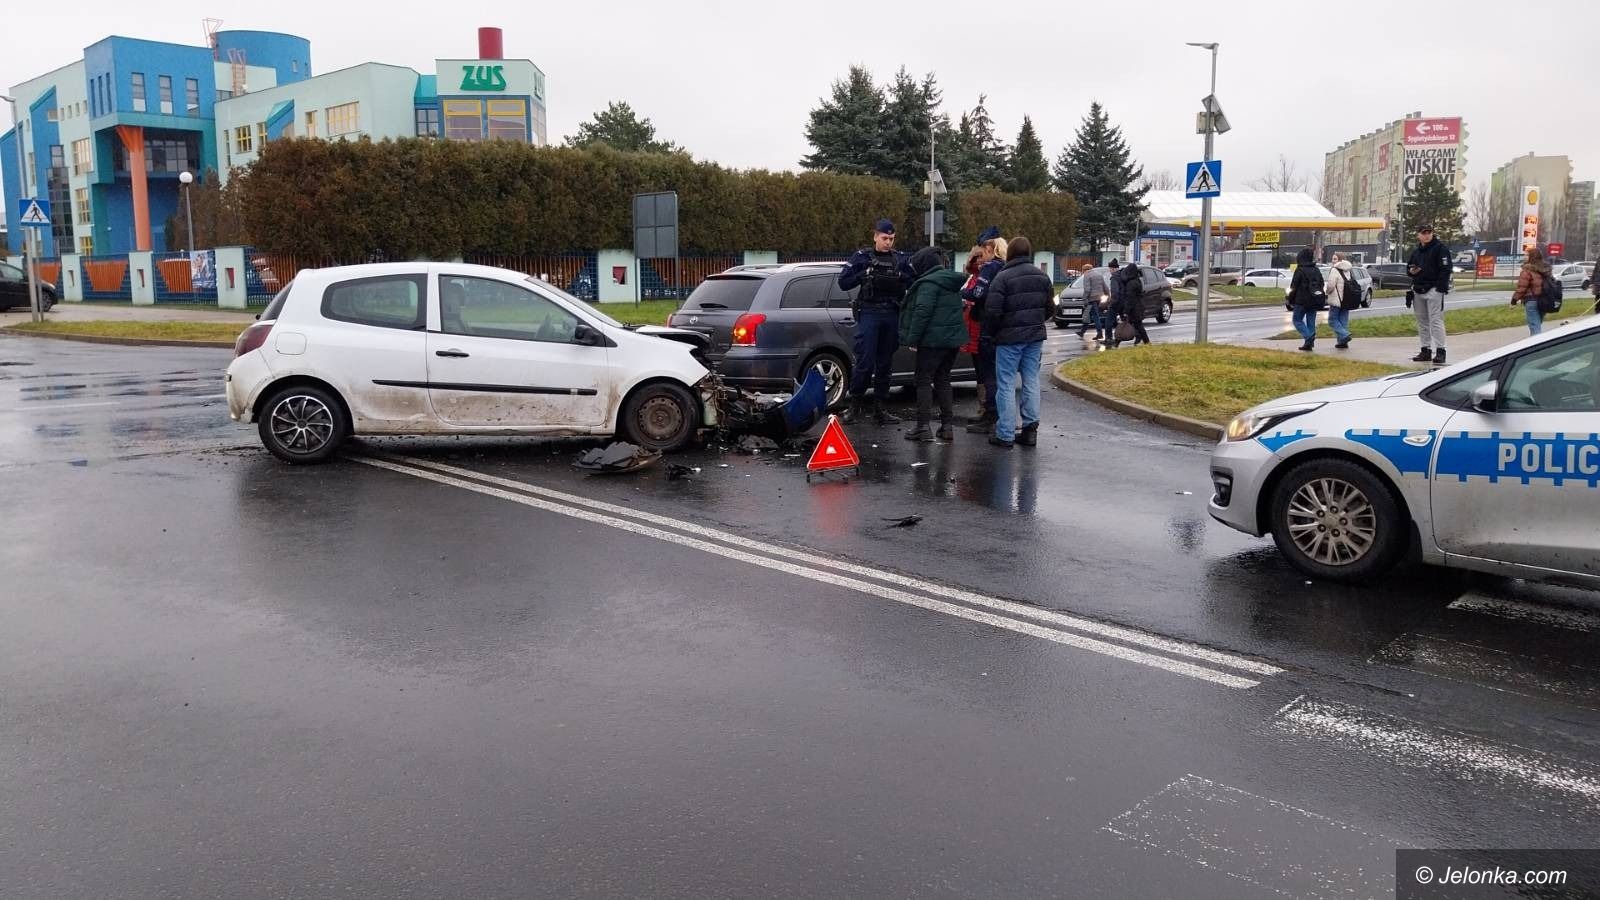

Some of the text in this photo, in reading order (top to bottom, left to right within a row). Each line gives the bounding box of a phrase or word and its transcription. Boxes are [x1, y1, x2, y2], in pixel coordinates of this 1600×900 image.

[460, 66, 507, 91] ZUS
[1405, 158, 1456, 175] NISKIE
[1404, 174, 1455, 196] CEY!
